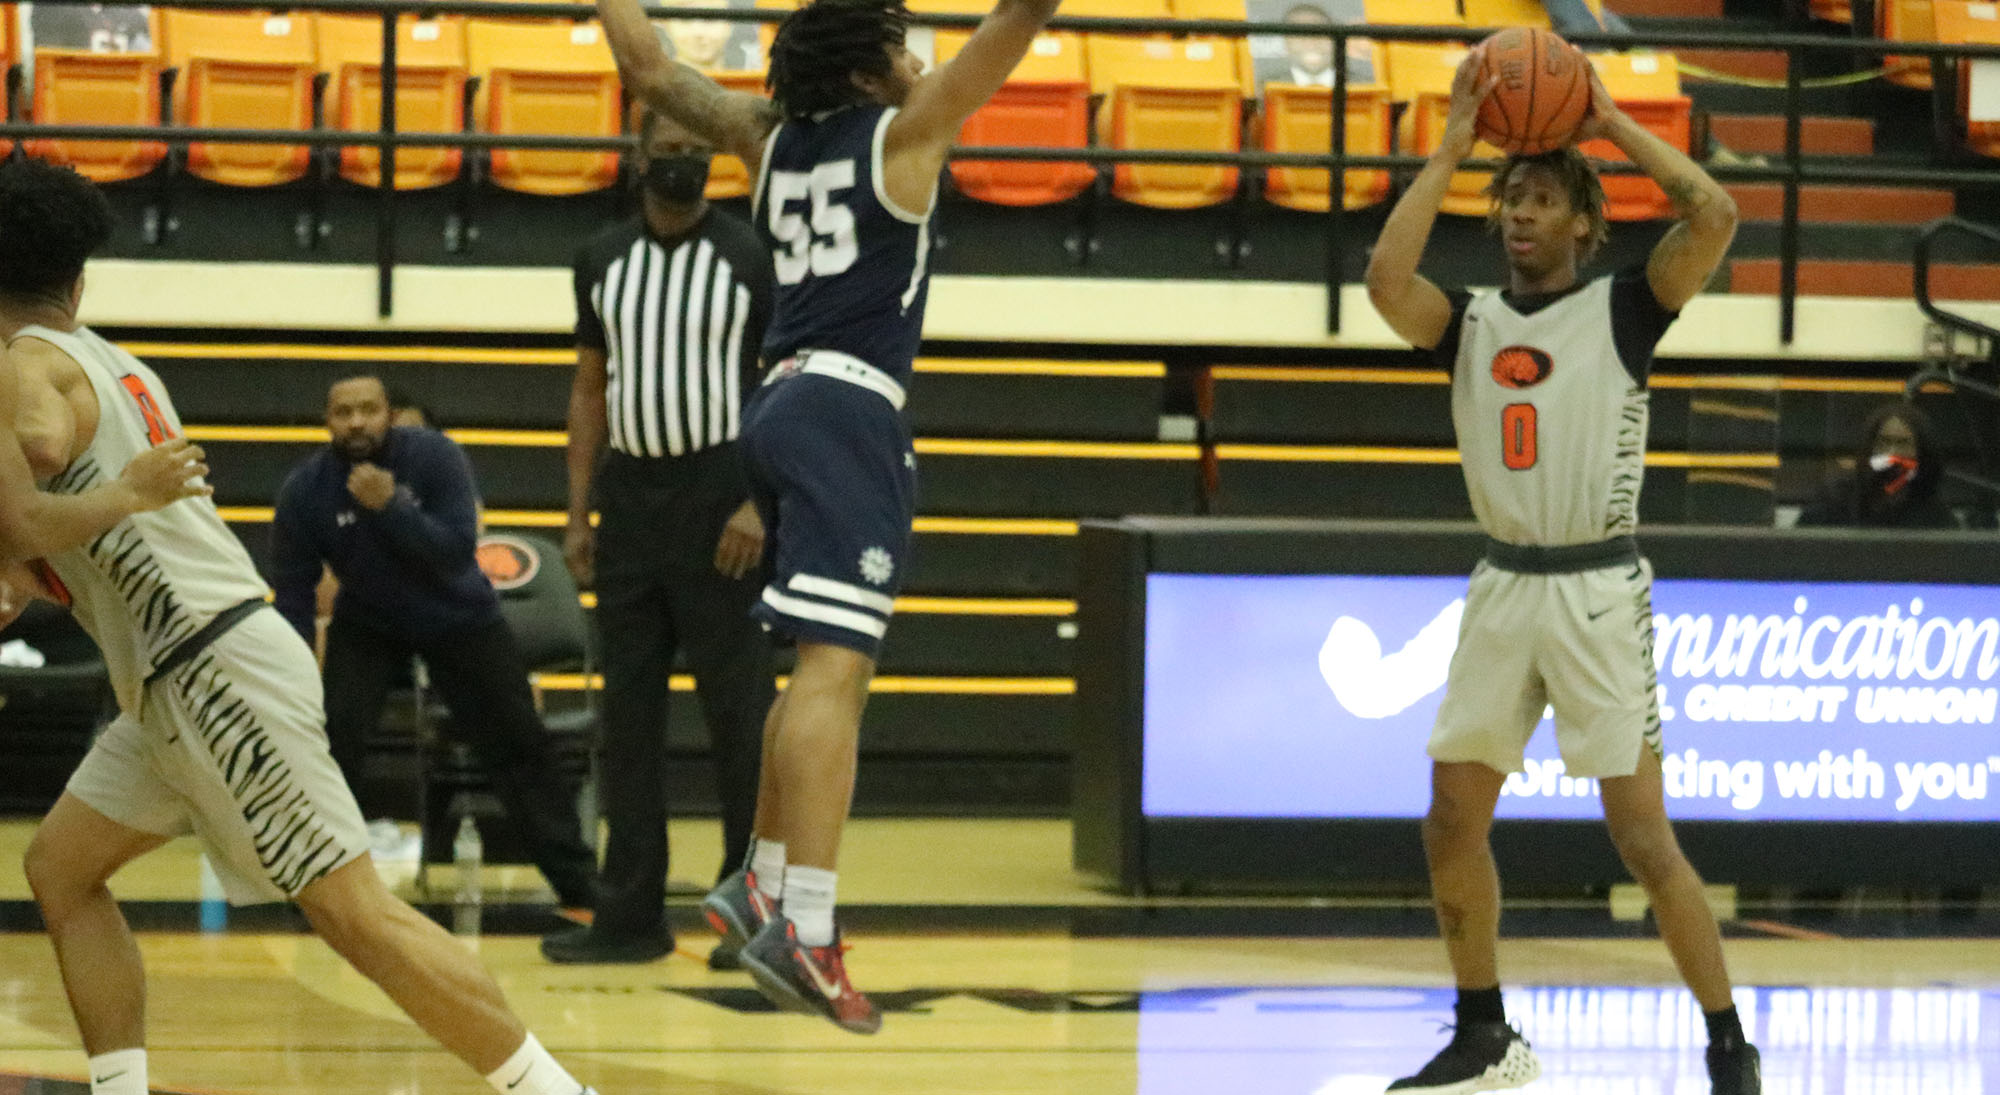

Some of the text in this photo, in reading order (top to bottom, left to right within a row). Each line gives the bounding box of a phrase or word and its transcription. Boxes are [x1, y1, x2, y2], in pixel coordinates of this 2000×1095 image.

[768, 157, 859, 286] 55
[1501, 403, 1537, 470] 0
[1652, 595, 1999, 680] munication
[1684, 683, 1848, 722] CREDIT
[1855, 686, 1998, 724] UNION
[1773, 748, 1884, 800] with
